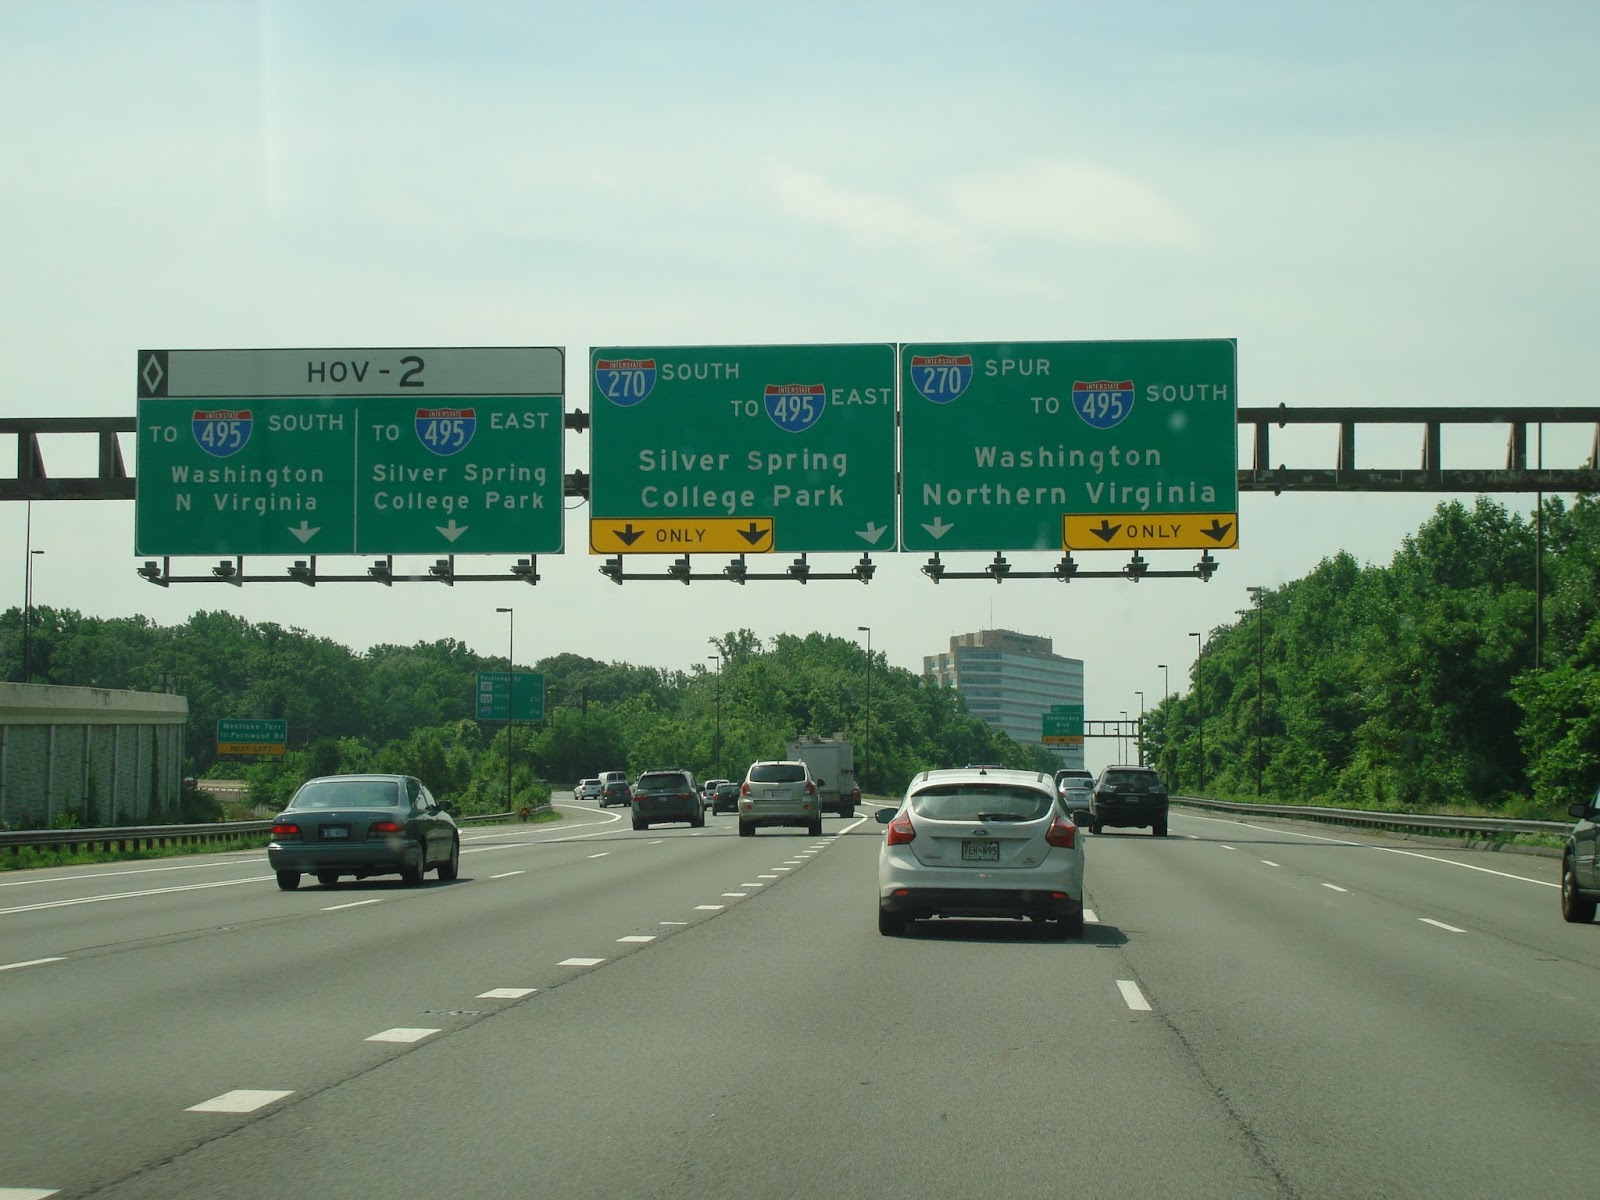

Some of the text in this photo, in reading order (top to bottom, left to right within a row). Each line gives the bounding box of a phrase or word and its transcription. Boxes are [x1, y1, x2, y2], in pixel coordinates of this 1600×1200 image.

[609, 361, 642, 369] INTERSTATE
[925, 357, 958, 365] INTERSTATE
[984, 358, 1051, 377] SPUR
[661, 362, 740, 380] SOUTH
[608, 371, 646, 397] 270
[923, 367, 962, 394] 270
[777, 386, 811, 394] INTERSTATE
[831, 388, 891, 406] EAST
[1146, 384, 1228, 402] SOUTH
[731, 400, 759, 417] TO
[774, 396, 814, 423] 495
[1030, 397, 1060, 414] TO
[1082, 392, 1123, 420] 495
[268, 414, 344, 431] SOUTH
[490, 412, 549, 430] EAST
[150, 426, 177, 443] TO
[201, 422, 241, 448] 495
[372, 424, 400, 441] TO
[424, 420, 465, 446] 495
[638, 448, 848, 477] Silver Spring
[974, 444, 1161, 474] Washington
[171, 465, 324, 488] Washington
[372, 463, 546, 487] Silver Spring
[175, 493, 317, 516] N Virginia
[374, 491, 544, 515] College Park
[641, 484, 844, 515] College Park
[923, 481, 1216, 511] Northern Virginia
[655, 528, 707, 543] ONLY
[1126, 524, 1182, 539] ONLY
[222, 722, 260, 730] Westlake
